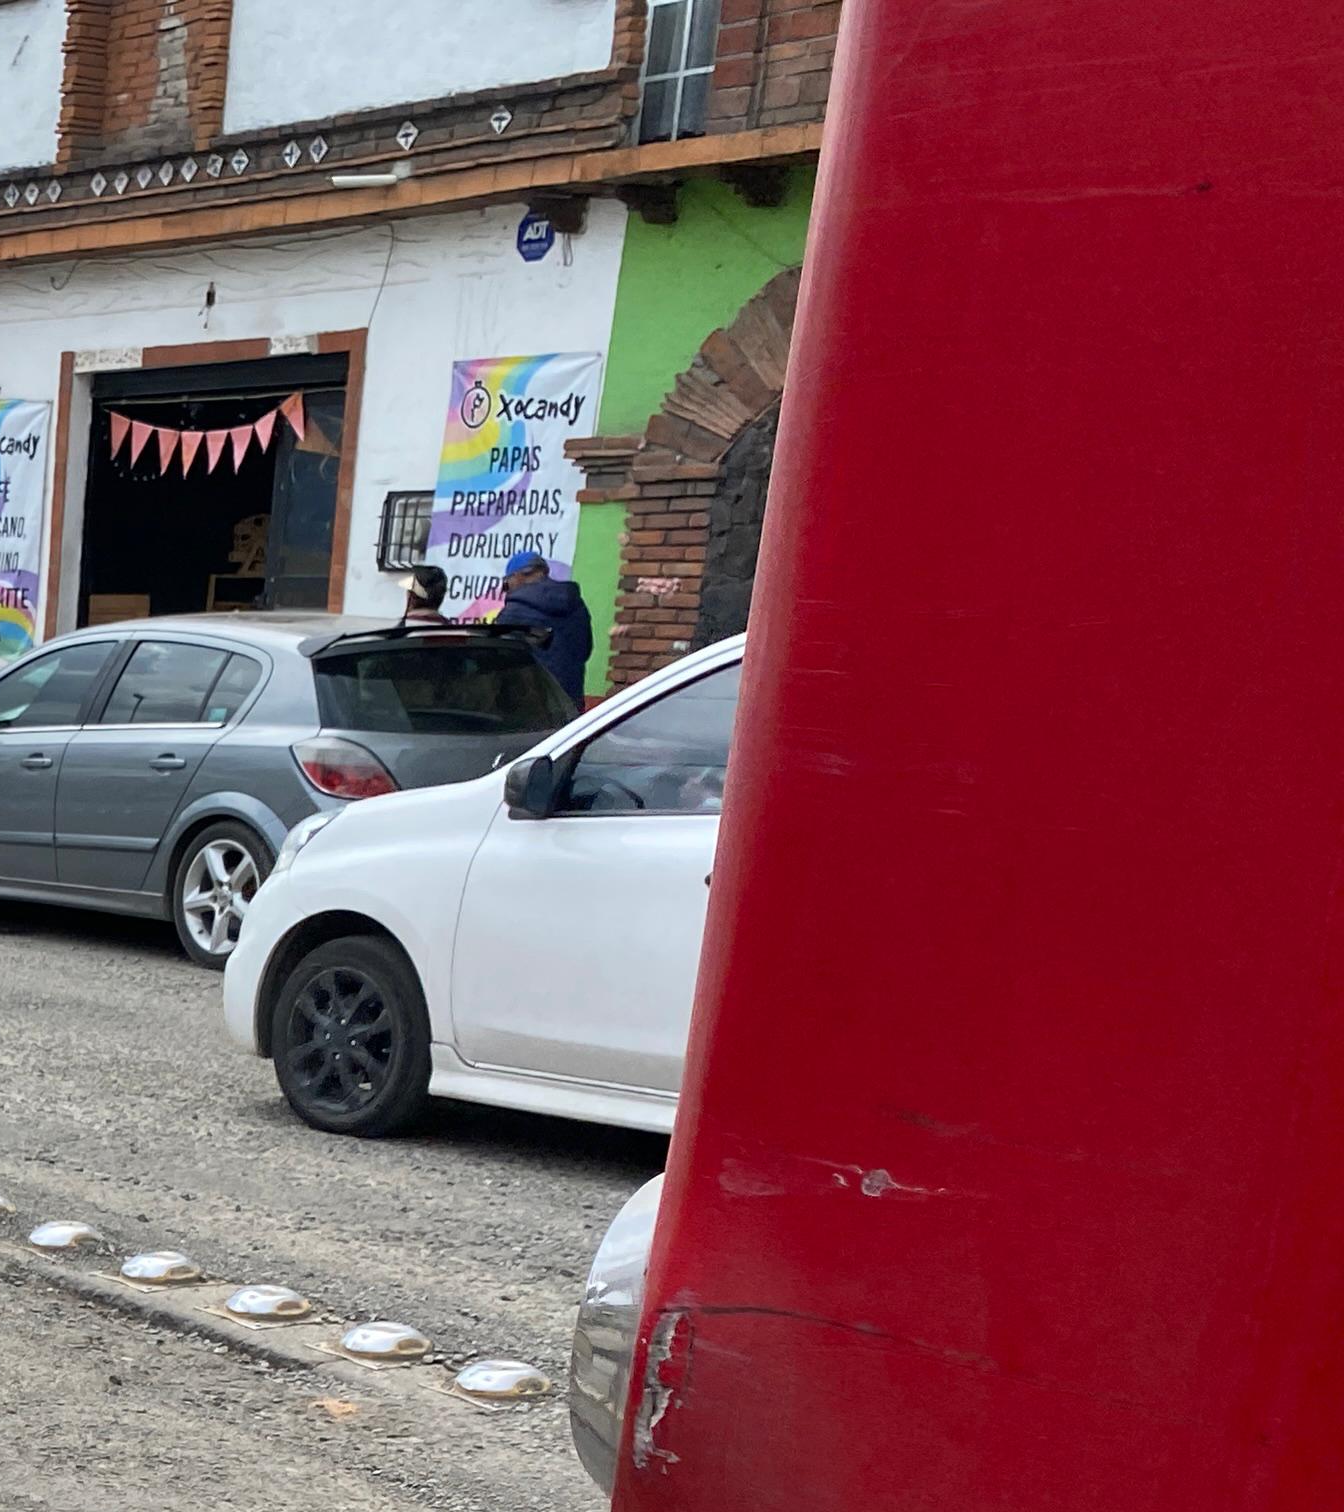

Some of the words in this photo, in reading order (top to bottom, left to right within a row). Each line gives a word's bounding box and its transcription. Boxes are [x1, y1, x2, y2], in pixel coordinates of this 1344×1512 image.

[522, 220, 550, 241] ADT
[489, 446, 542, 473] PAPAS
[450, 489, 565, 519] PREPARADAS,
[545, 532, 559, 558] Y
